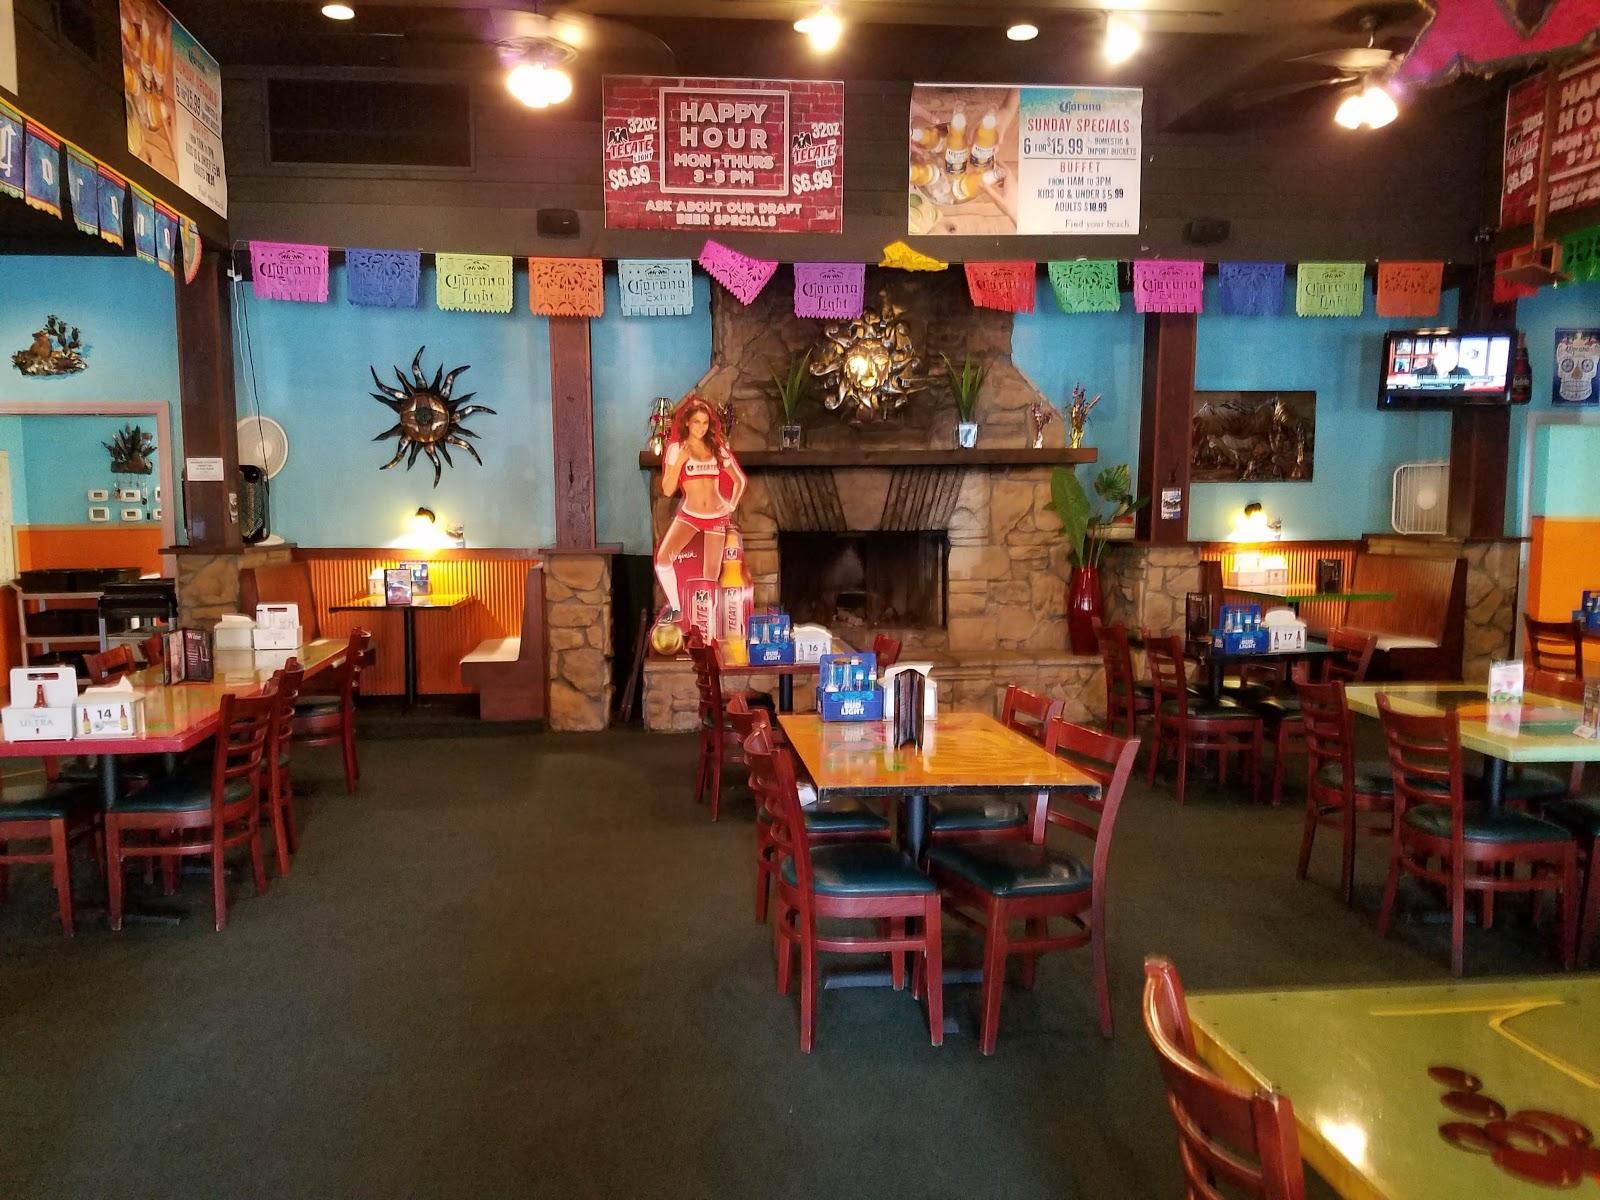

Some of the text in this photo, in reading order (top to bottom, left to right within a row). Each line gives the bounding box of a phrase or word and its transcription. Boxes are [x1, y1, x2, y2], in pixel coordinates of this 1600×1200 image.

[680, 102, 768, 124] HAPPY
[1059, 101, 1101, 114] Corona
[1027, 118, 1130, 133] SUNDAY SPECIALS
[680, 127, 768, 149] HOUR
[607, 140, 653, 159] TECATE
[1023, 137, 1083, 155] 6 FOR $15.99
[793, 144, 836, 164] TECATE
[1060, 162, 1101, 173] BUFFET
[608, 165, 651, 190] $6.99
[730, 170, 754, 184] PM
[792, 170, 832, 195] $6.99
[1048, 178, 1065, 186] FROM
[1067, 176, 1084, 186] 11AM
[1095, 177, 1112, 186] 3PM
[1037, 189, 1055, 199] KIDS
[1057, 189, 1065, 199] 10
[1067, 189, 1073, 199] &
[1075, 189, 1100, 199] UNDER
[645, 200, 673, 212] ASK
[676, 201, 722, 213] ABOUT
[726, 202, 755, 214] OUR
[759, 203, 802, 215] DRAFT
[1055, 202, 1082, 212] ADULTS
[676, 213, 777, 227] BEER SPECIALS
[1065, 219, 1084, 228] Find
[1086, 221, 1105, 229] your
[259, 262, 321, 279] Corona
[445, 274, 505, 290] Corona
[628, 279, 685, 296] Corona
[1142, 279, 1197, 293] Corona
[1305, 282, 1358, 296] Corona
[462, 288, 494, 304] Light
[802, 282, 858, 298] Corona
[817, 296, 847, 311] Light
[1284, 633, 1293, 641] 17
[808, 644, 818, 652] 16
[840, 708, 865, 716] LIGHT
[844, 701, 863, 709] BUD
[97, 708, 112, 720] 14
